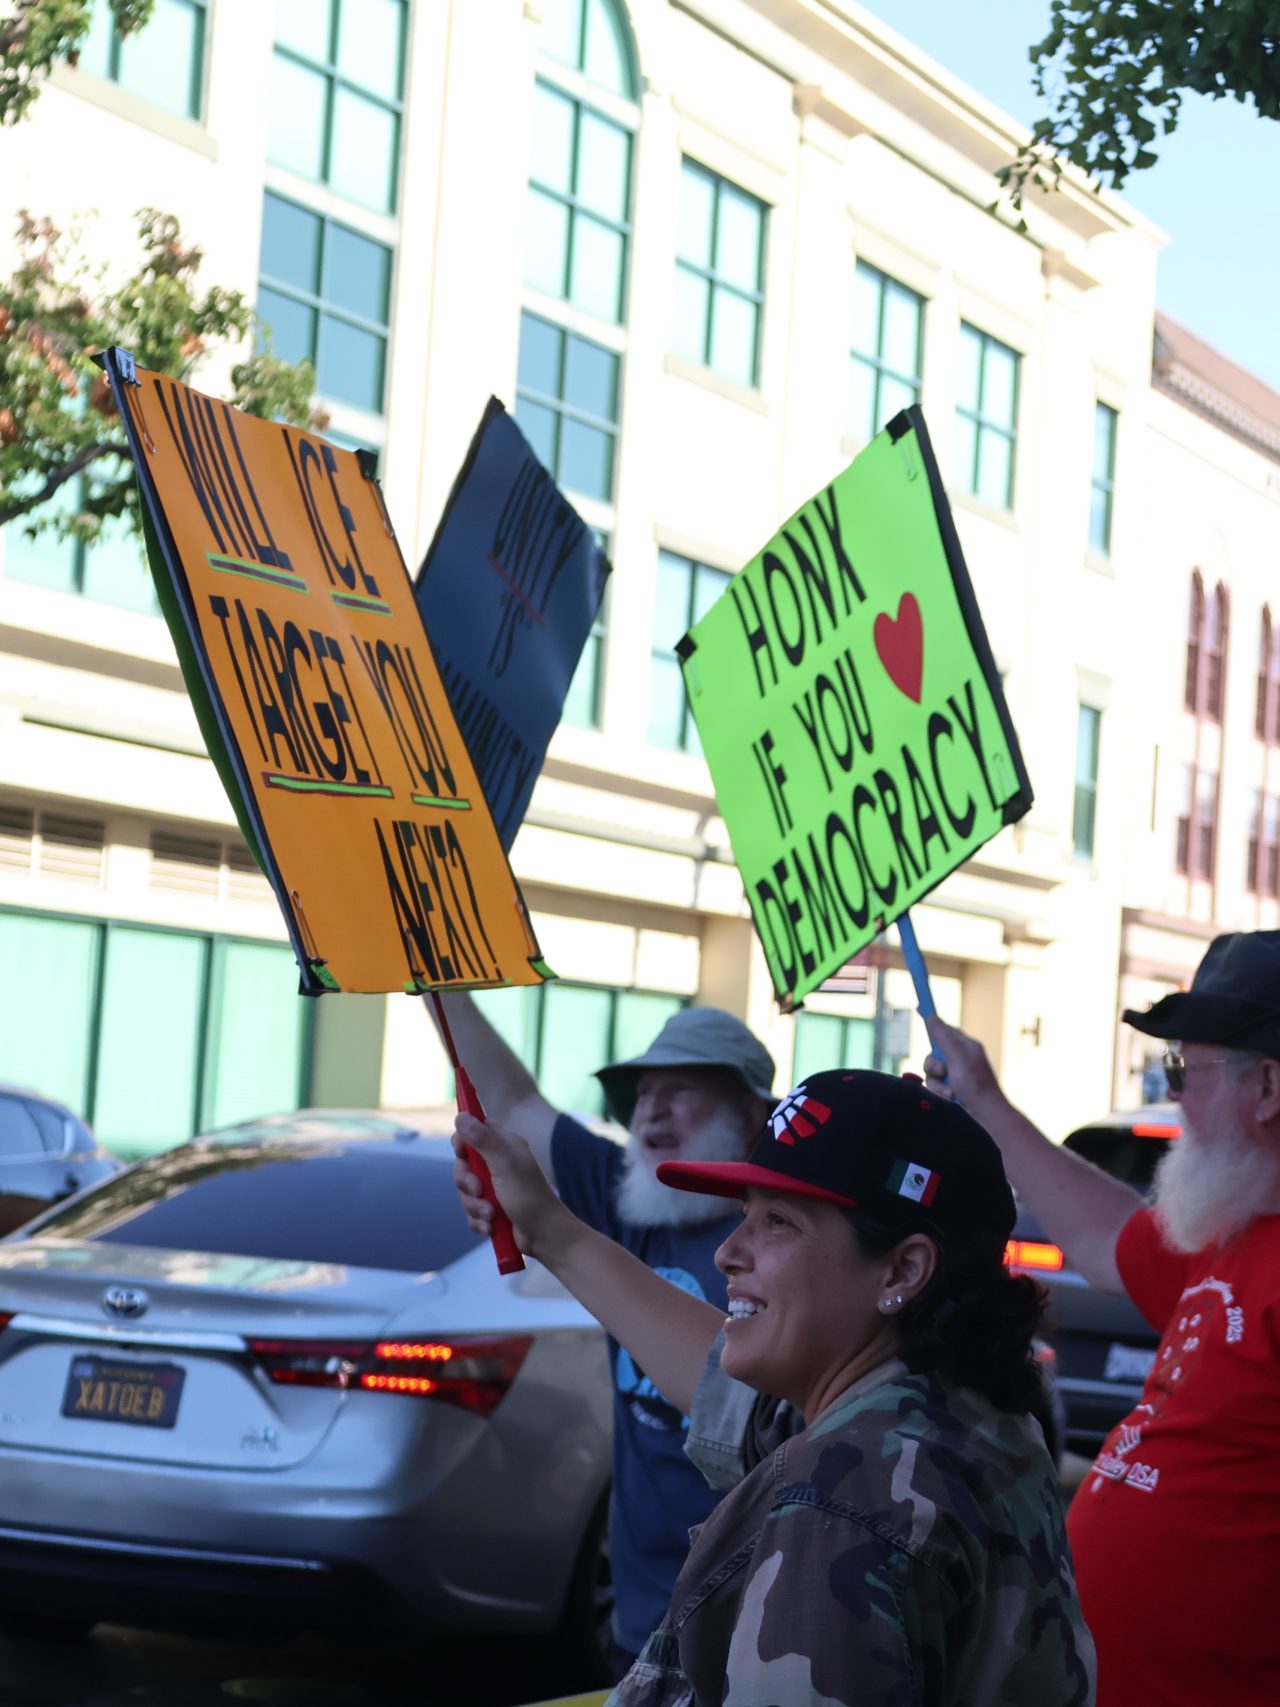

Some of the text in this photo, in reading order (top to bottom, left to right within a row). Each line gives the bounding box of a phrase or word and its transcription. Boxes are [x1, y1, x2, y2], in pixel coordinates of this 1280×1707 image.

[154, 379, 381, 597] WILL ICE
[493, 456, 586, 616] UNITY
[731, 485, 867, 698] HONK
[208, 595, 457, 797] TARGET YOU
[752, 647, 875, 839] IF YOU
[373, 818, 504, 981] NEXT?
[755, 679, 1004, 991] DEMOCRACY
